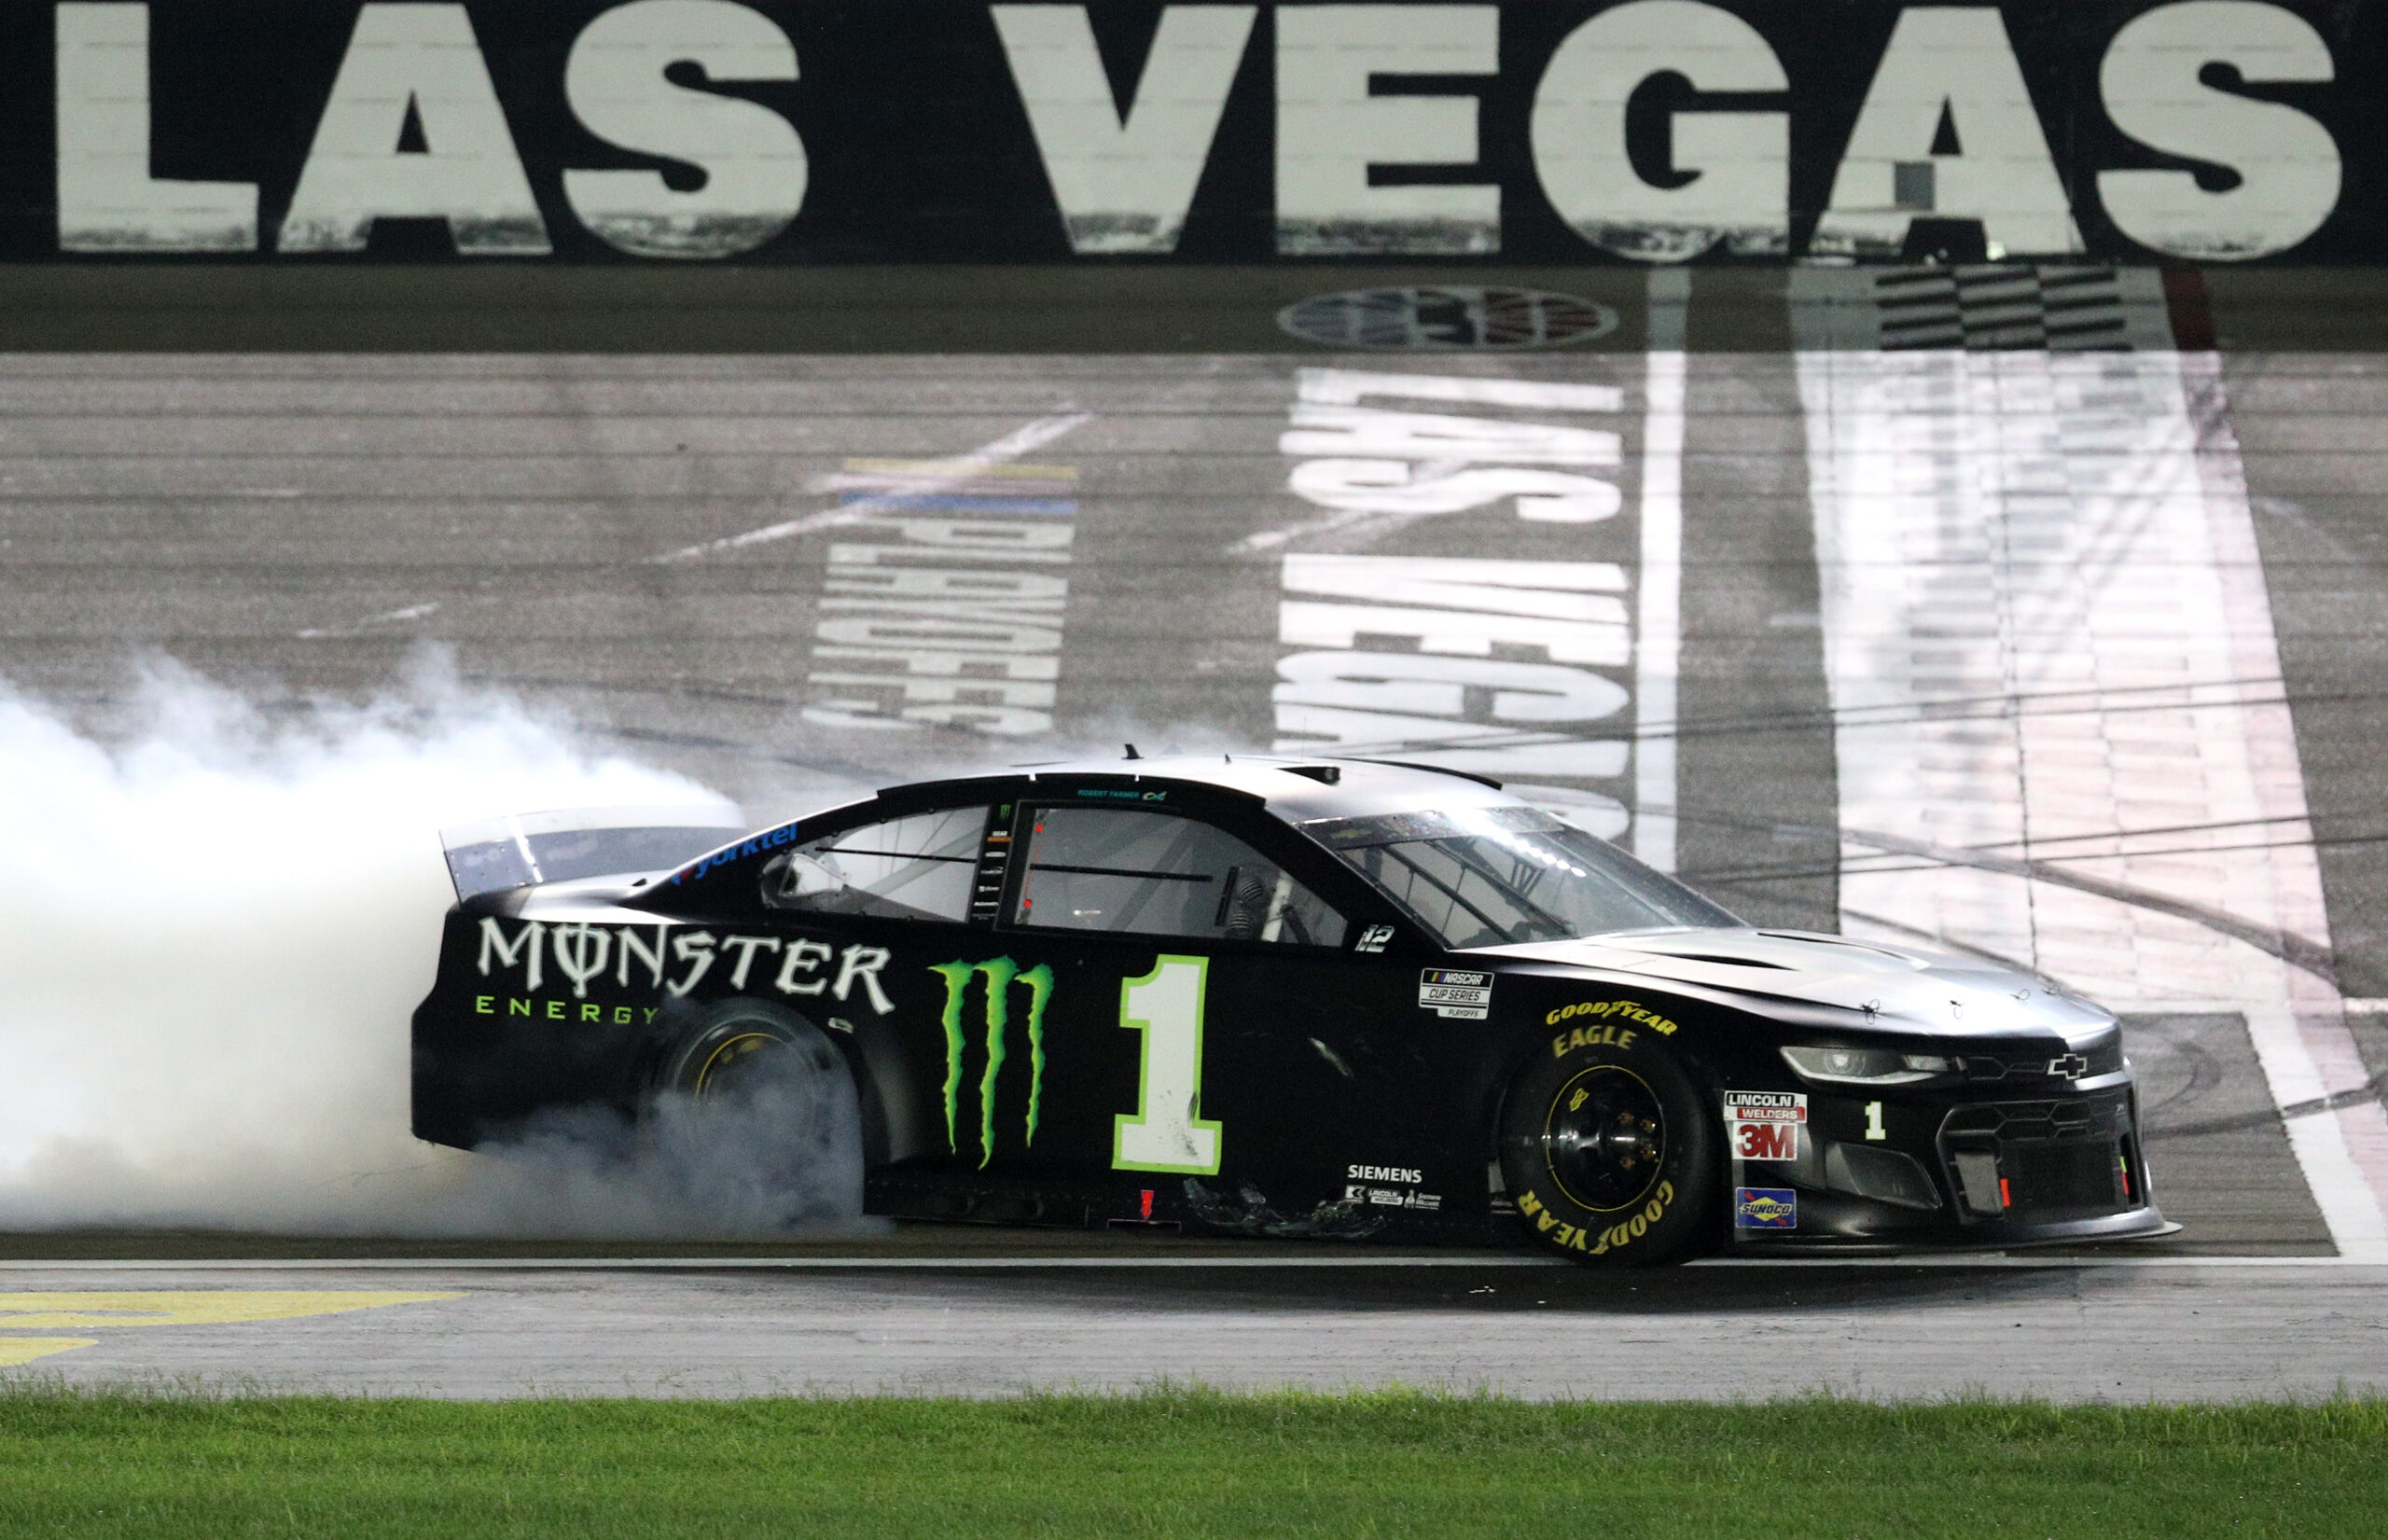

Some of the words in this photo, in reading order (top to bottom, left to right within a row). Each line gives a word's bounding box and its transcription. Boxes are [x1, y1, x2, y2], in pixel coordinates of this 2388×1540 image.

[56, 1, 808, 258] LAS
[990, 1, 2342, 262] VEGAS
[1278, 367, 1624, 523] LAS
[801, 517, 1076, 736] PLAYOFFS
[694, 823, 798, 881] yorktel
[1354, 923, 1395, 953] 12
[1429, 988, 1448, 999] CUP
[1448, 990, 1481, 1001] SERIES
[1443, 972, 1484, 986] NASCAR
[476, 994, 659, 1025] ENERGY
[1448, 1008, 1479, 1018] PLAYOFFS
[1547, 1000, 1678, 1036] GOODYEAR
[1553, 1025, 1637, 1058] EAGLE
[1111, 953, 1223, 1175] 1
[1729, 1093, 1792, 1107] LINCOLN
[1742, 1108, 1798, 1120] WELDERS
[1865, 1101, 1886, 1141] 1
[1737, 1123, 1795, 1158] 3M
[1348, 1164, 1423, 1184] SIEMENS
[1517, 1179, 1674, 1256] GOODYEAR
[1741, 1203, 1793, 1214] SUNOCO
